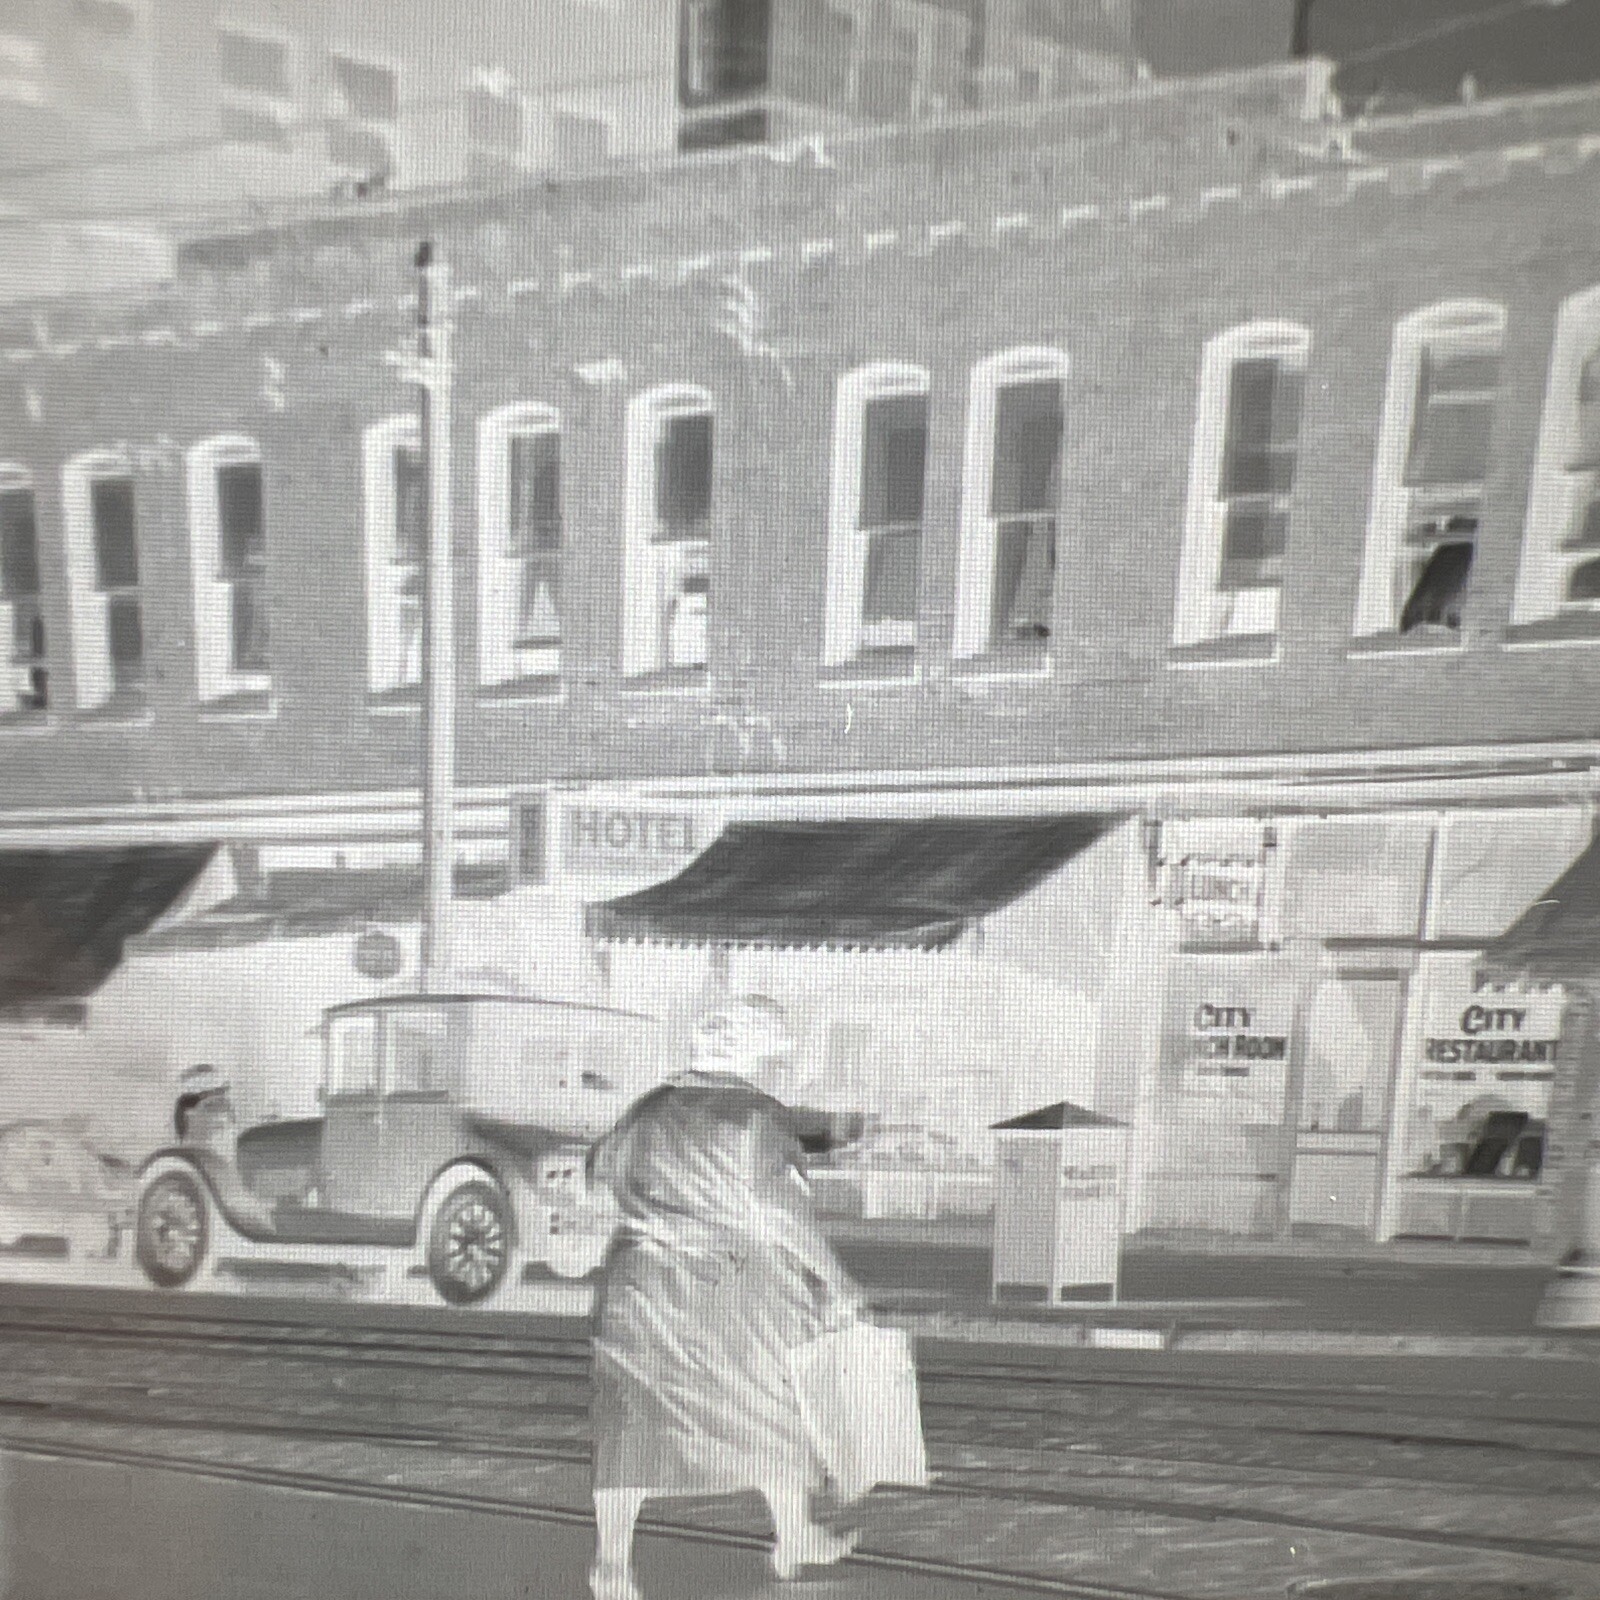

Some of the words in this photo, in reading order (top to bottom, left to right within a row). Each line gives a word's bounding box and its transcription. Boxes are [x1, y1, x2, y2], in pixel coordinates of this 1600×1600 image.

[571, 808, 695, 853] HOTEL
[1194, 1003, 1256, 1031] CITY
[1461, 1004, 1527, 1035] CITY
